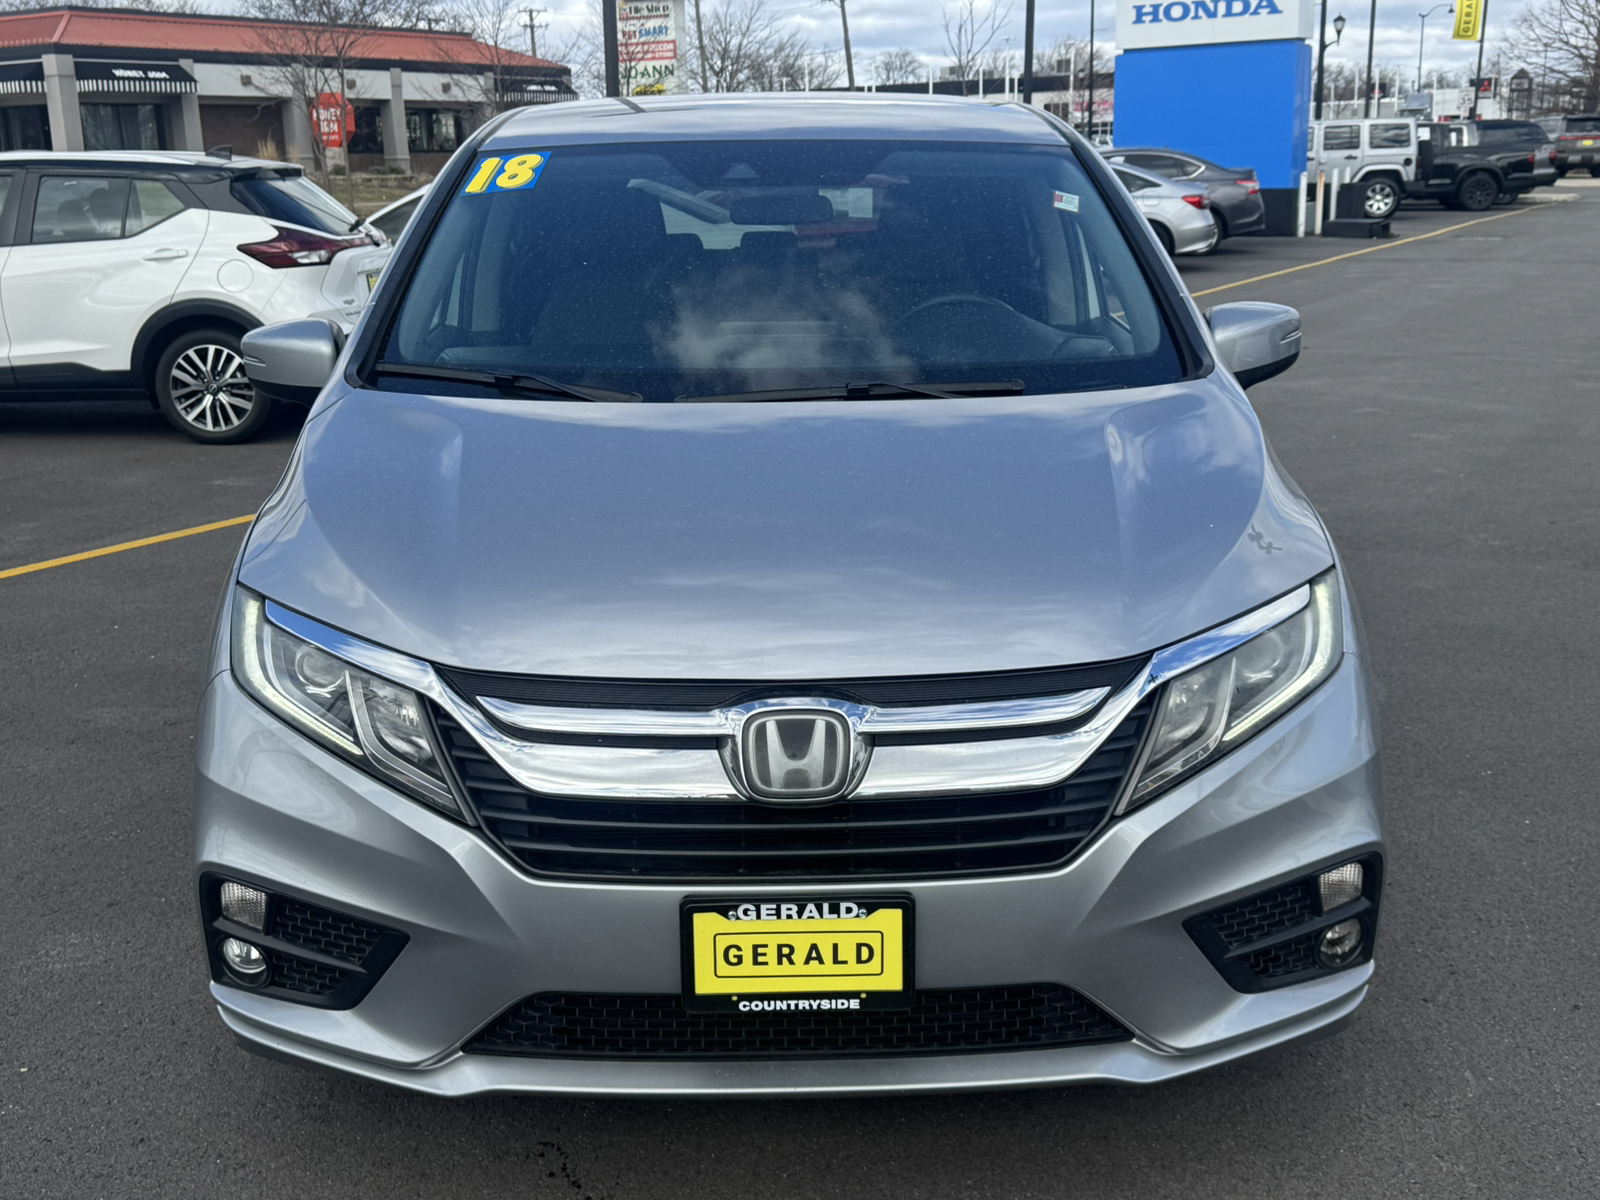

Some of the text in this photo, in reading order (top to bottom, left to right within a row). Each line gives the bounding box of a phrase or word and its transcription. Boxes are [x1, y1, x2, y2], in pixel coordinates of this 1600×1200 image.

[1131, 0, 1284, 25] HONDA
[1462, 0, 1474, 33] GERA
[111, 68, 146, 78] HONEY
[465, 153, 544, 194] 18
[737, 902, 859, 921] GERALD
[722, 942, 875, 966] GERALD
[738, 998, 861, 1012] COUNTRYSIDE
